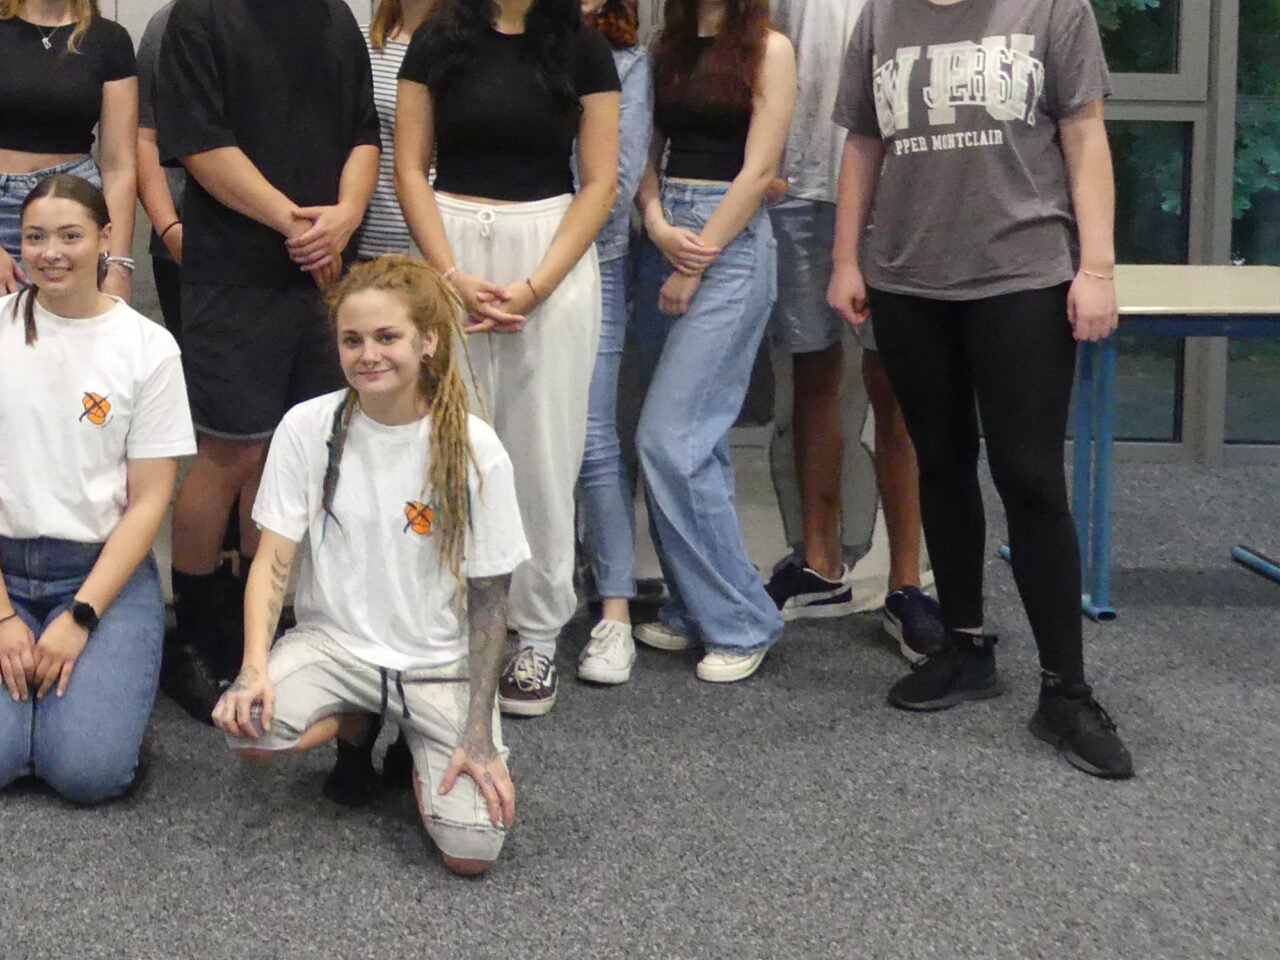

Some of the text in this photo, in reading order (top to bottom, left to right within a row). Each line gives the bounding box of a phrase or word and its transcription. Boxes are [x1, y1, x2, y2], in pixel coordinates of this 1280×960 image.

[922, 43, 1045, 126] JERSEY
[894, 129, 1004, 155] PPER MONTCLAIR
